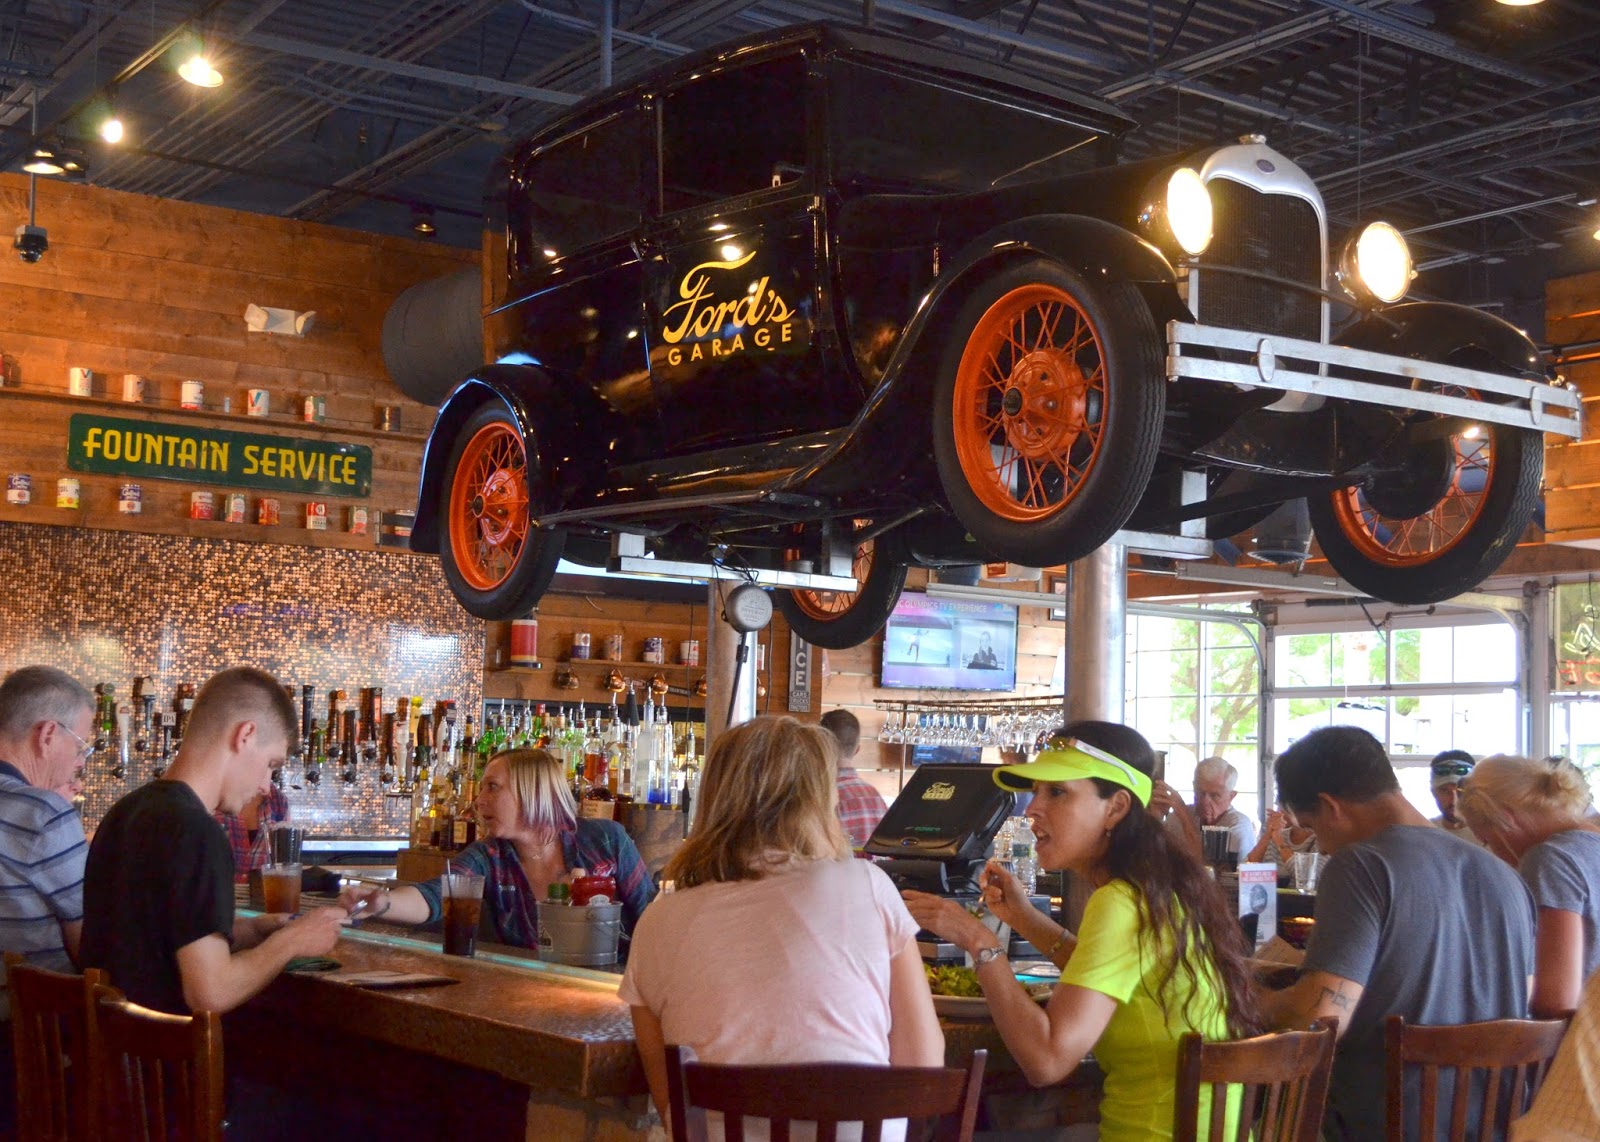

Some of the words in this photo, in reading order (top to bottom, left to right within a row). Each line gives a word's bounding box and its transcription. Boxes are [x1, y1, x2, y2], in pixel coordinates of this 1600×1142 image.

[662, 250, 796, 344] Ford's
[668, 323, 792, 366] GARAGE
[82, 427, 229, 472] FOUNTAIN
[243, 446, 356, 486] SERVICE
[905, 601, 938, 610] OLYMPICS
[939, 602, 948, 611] TV
[949, 603, 988, 613] EXPERIENCE
[163, 715, 175, 723] IPA
